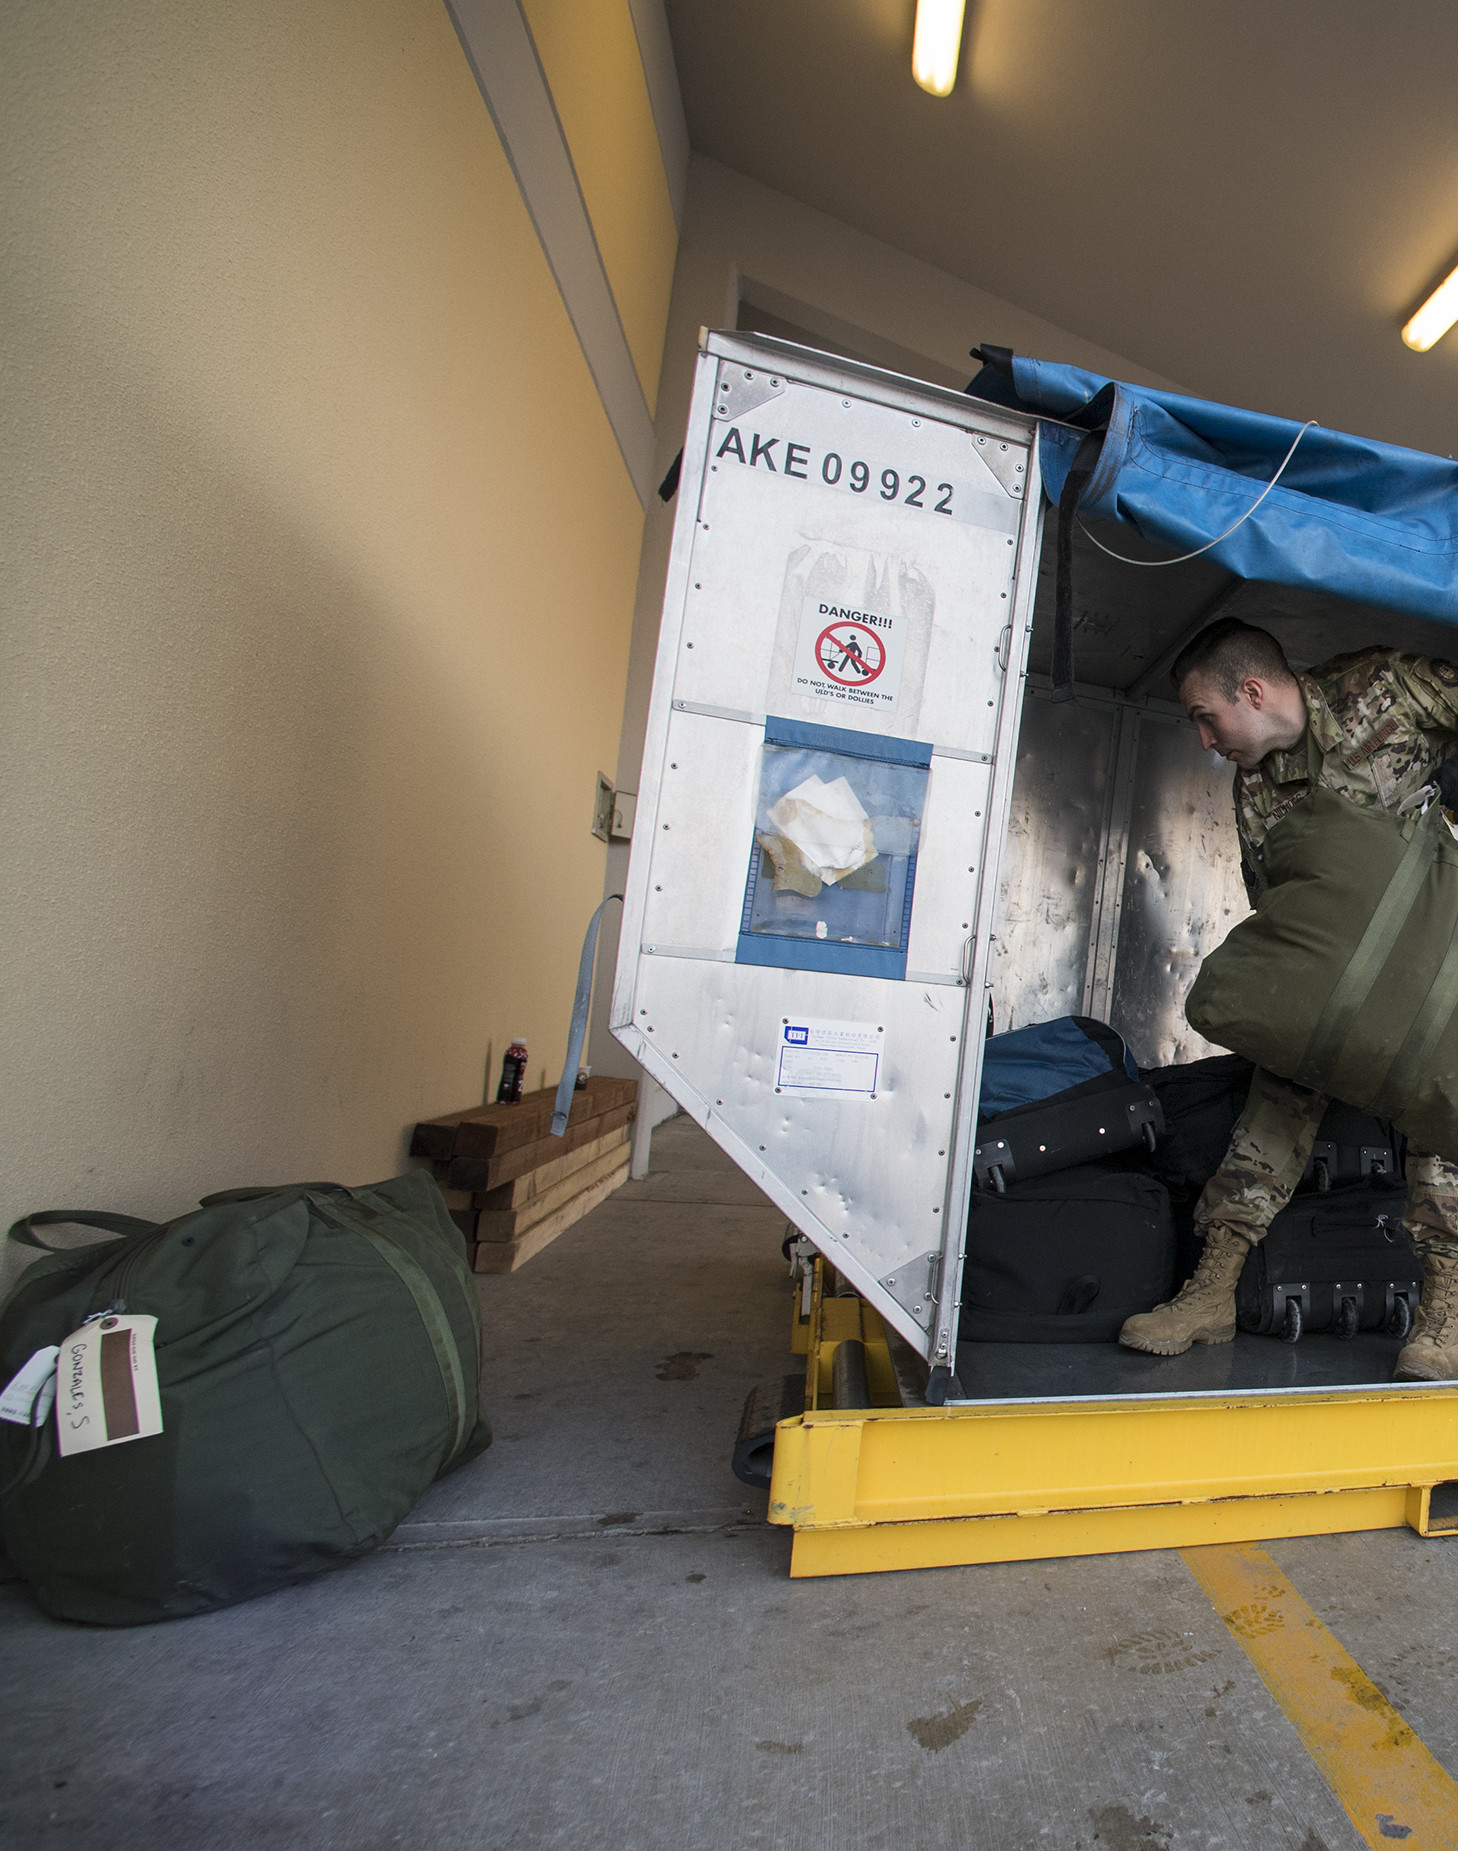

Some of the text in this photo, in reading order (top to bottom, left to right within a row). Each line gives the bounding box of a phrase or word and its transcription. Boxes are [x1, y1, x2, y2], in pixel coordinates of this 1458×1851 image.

[716, 427, 954, 516] AKE 09922
[818, 603, 893, 629] DANGER!!!
[797, 677, 893, 702] DO NOT WALK BETWEEN THE
[815, 688, 875, 705] ULD'S OR DOLLIES
[1360, 740, 1374, 757] AIR
[1371, 719, 1398, 748] FORCE
[71, 1415, 90, 1430] S
